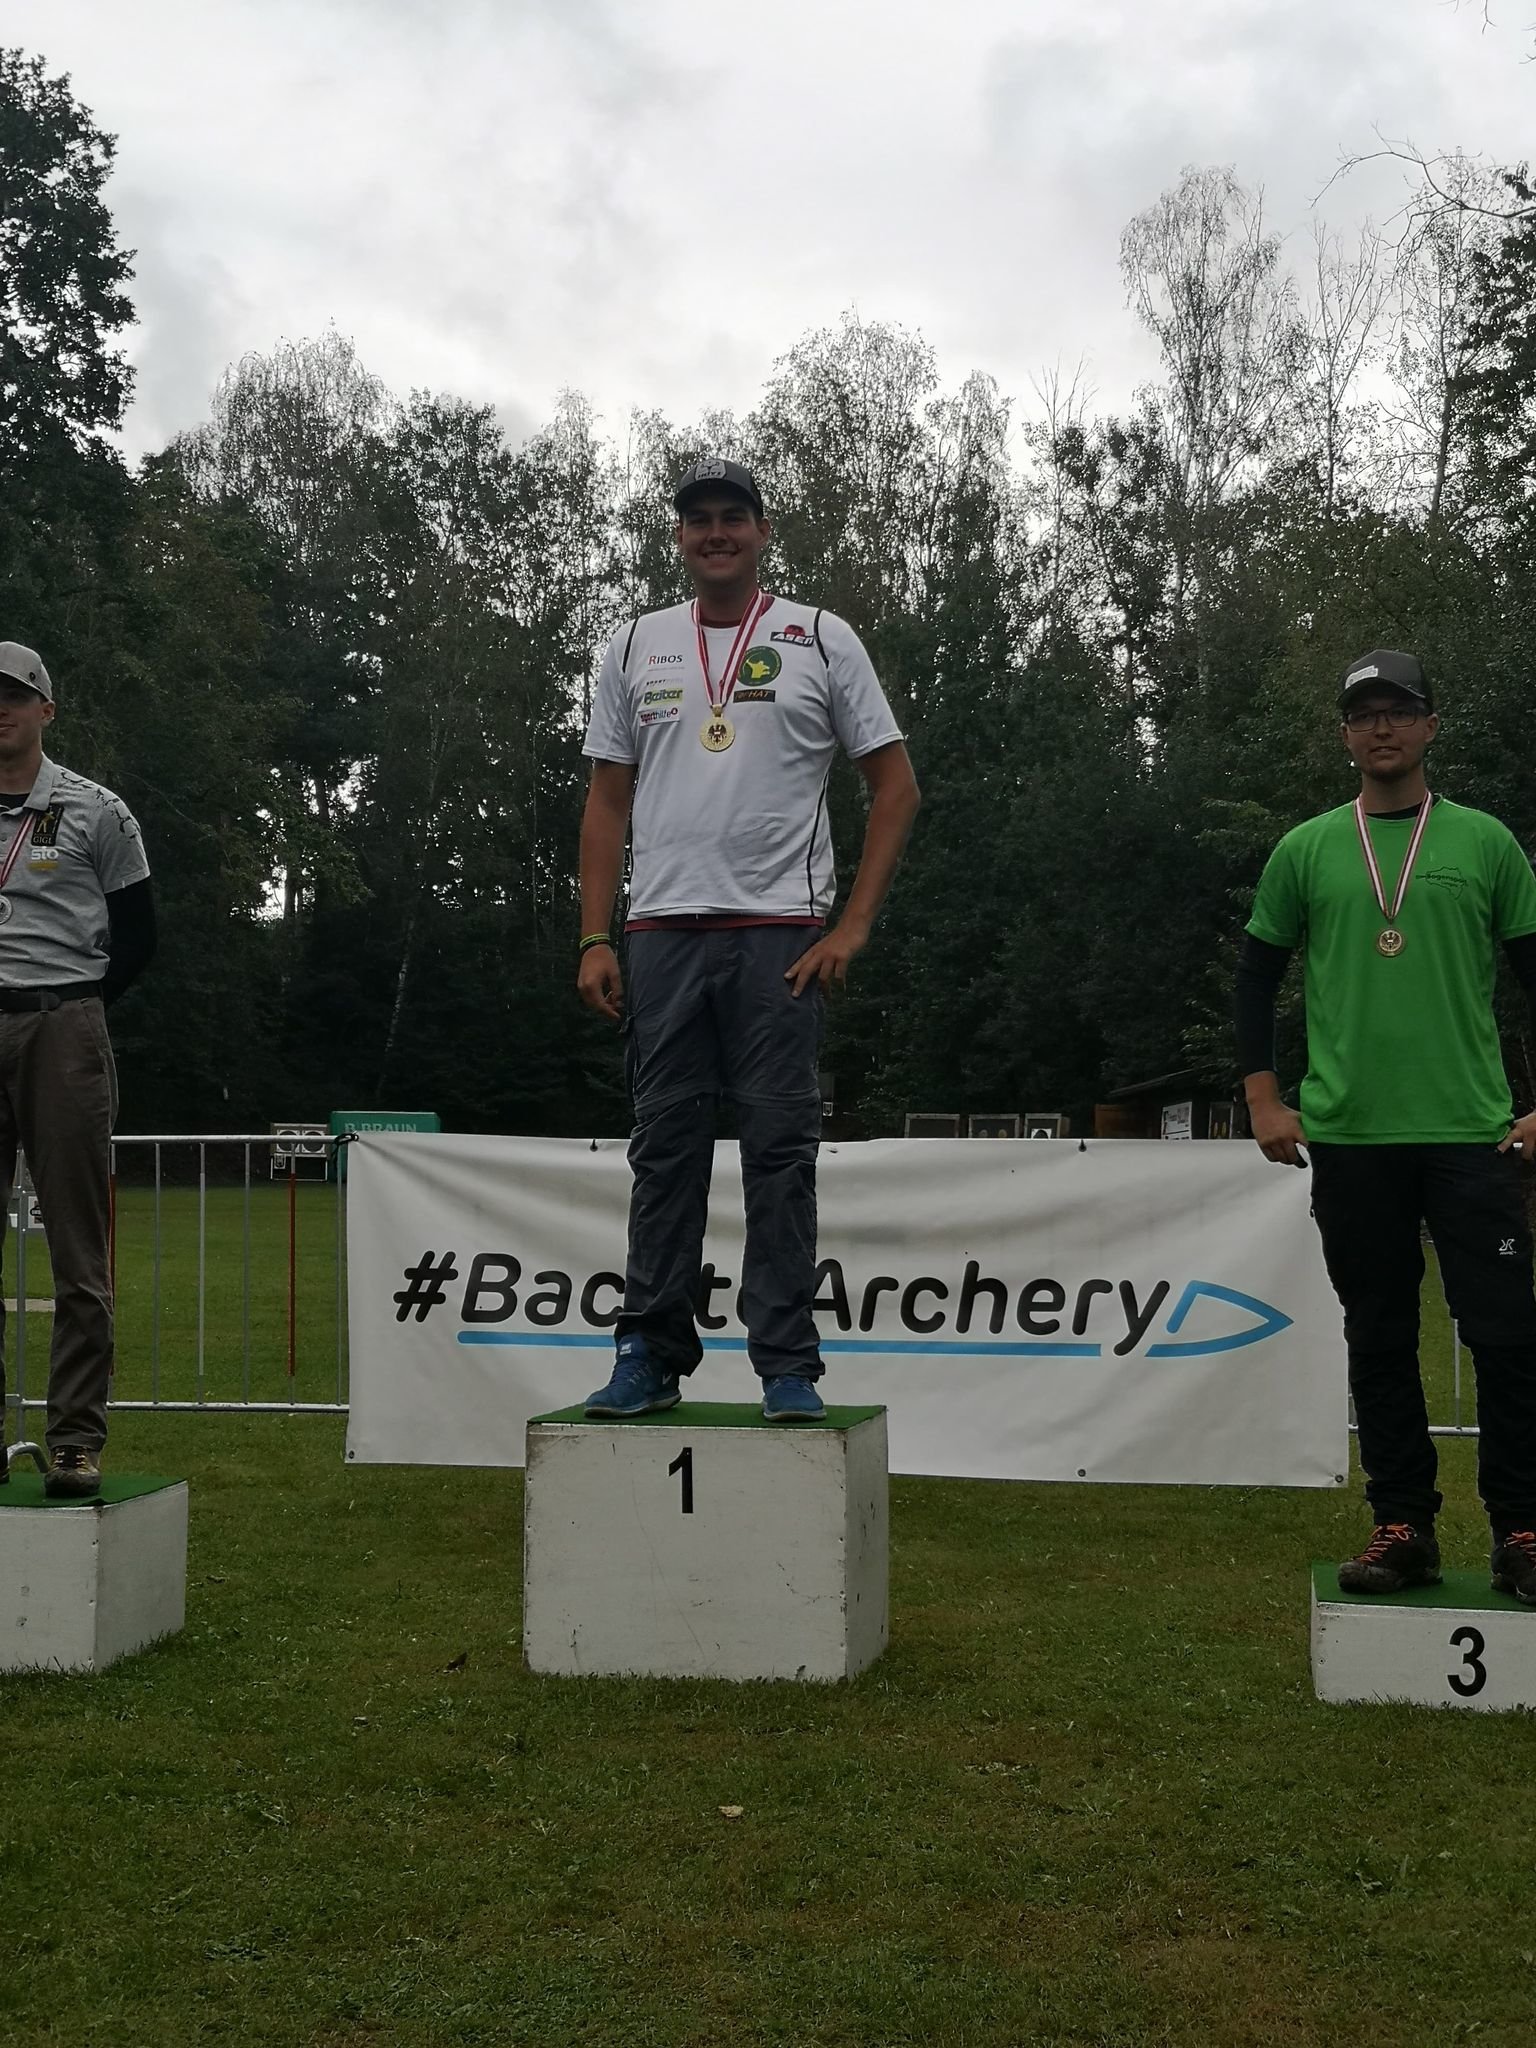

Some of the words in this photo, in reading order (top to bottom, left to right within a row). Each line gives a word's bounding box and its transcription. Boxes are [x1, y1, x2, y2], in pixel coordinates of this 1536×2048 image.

[648, 655, 683, 665] RIBOS
[361, 1122, 417, 1133] BRAUN
[668, 1447, 693, 1513] 1
[1447, 1626, 1487, 1697] 3
